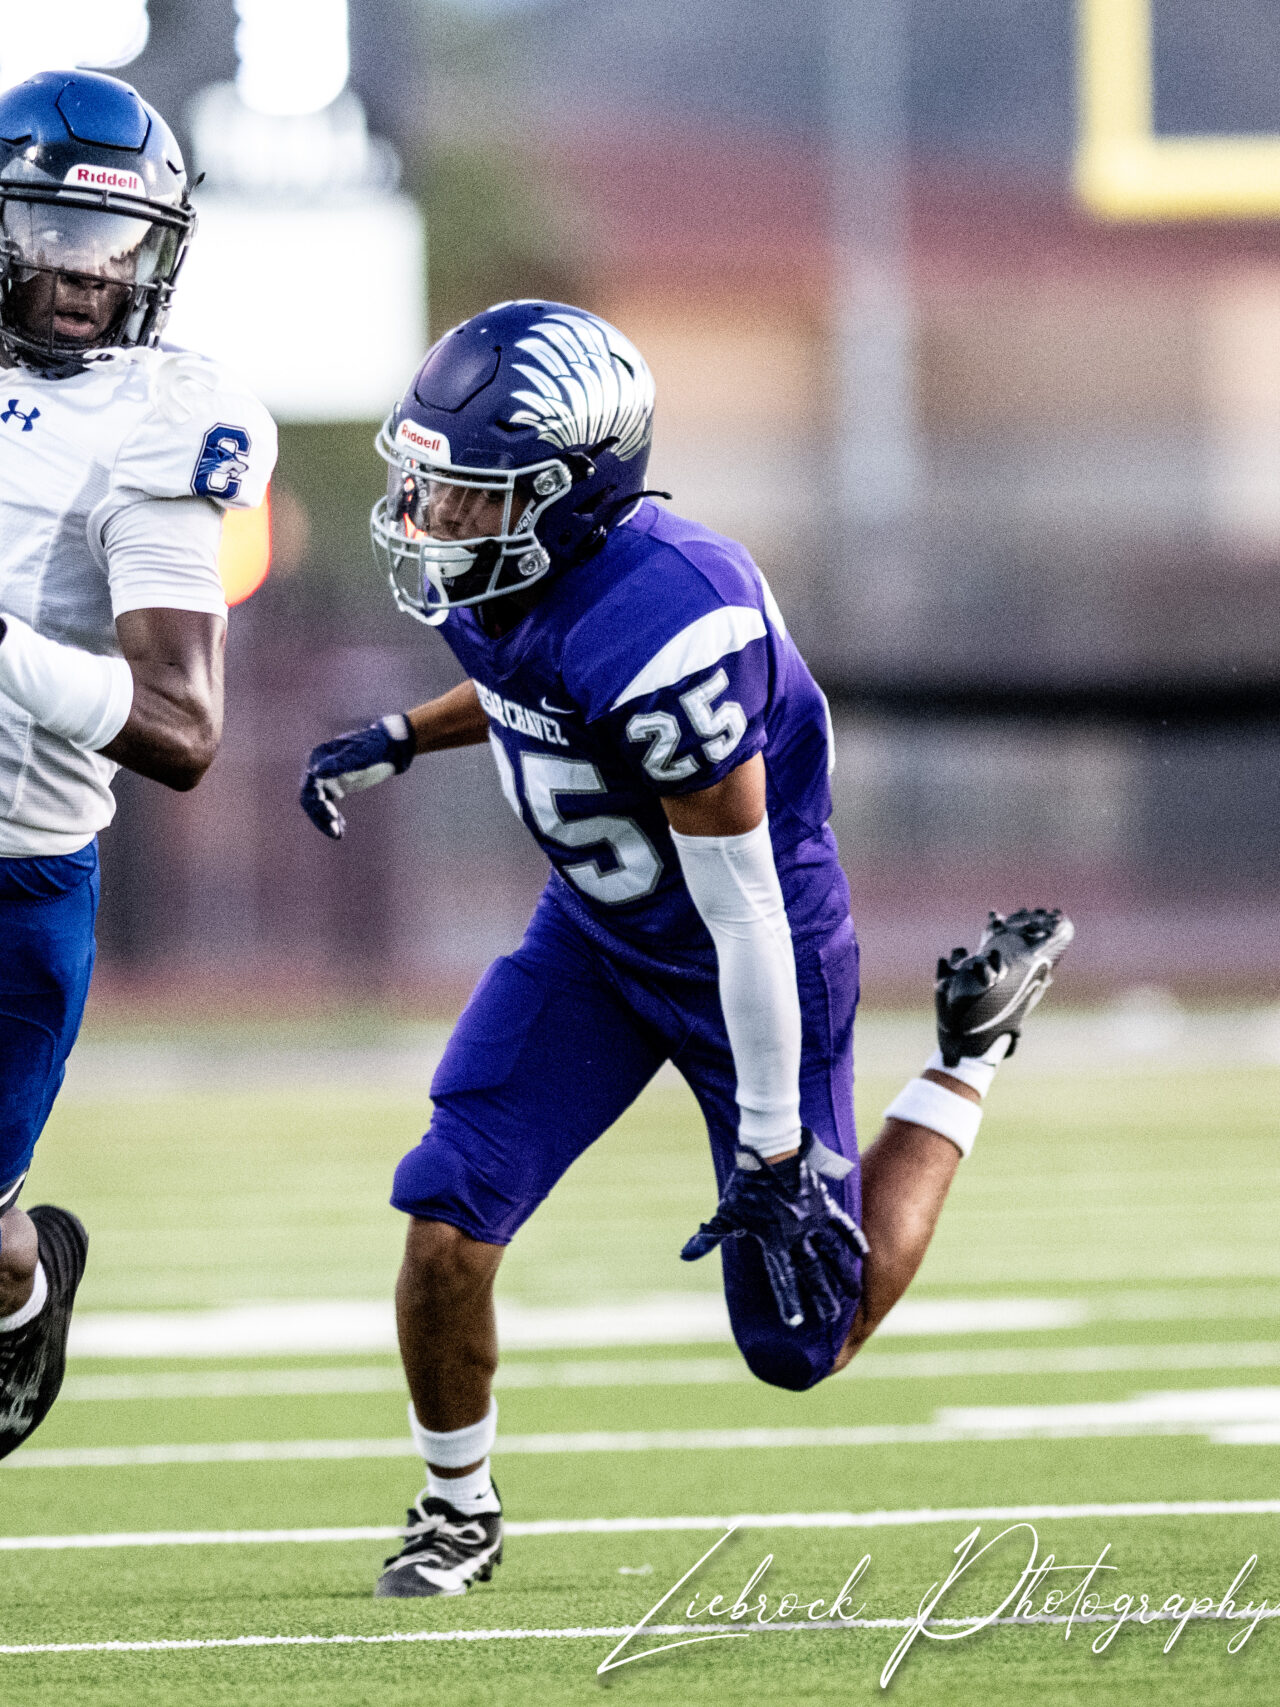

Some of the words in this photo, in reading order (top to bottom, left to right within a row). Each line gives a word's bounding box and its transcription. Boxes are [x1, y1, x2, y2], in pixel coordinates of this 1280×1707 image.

[77, 168, 138, 190] Riddell
[401, 423, 441, 452] Riddell
[502, 699, 570, 746] CHAVEZ
[626, 667, 748, 783] 25
